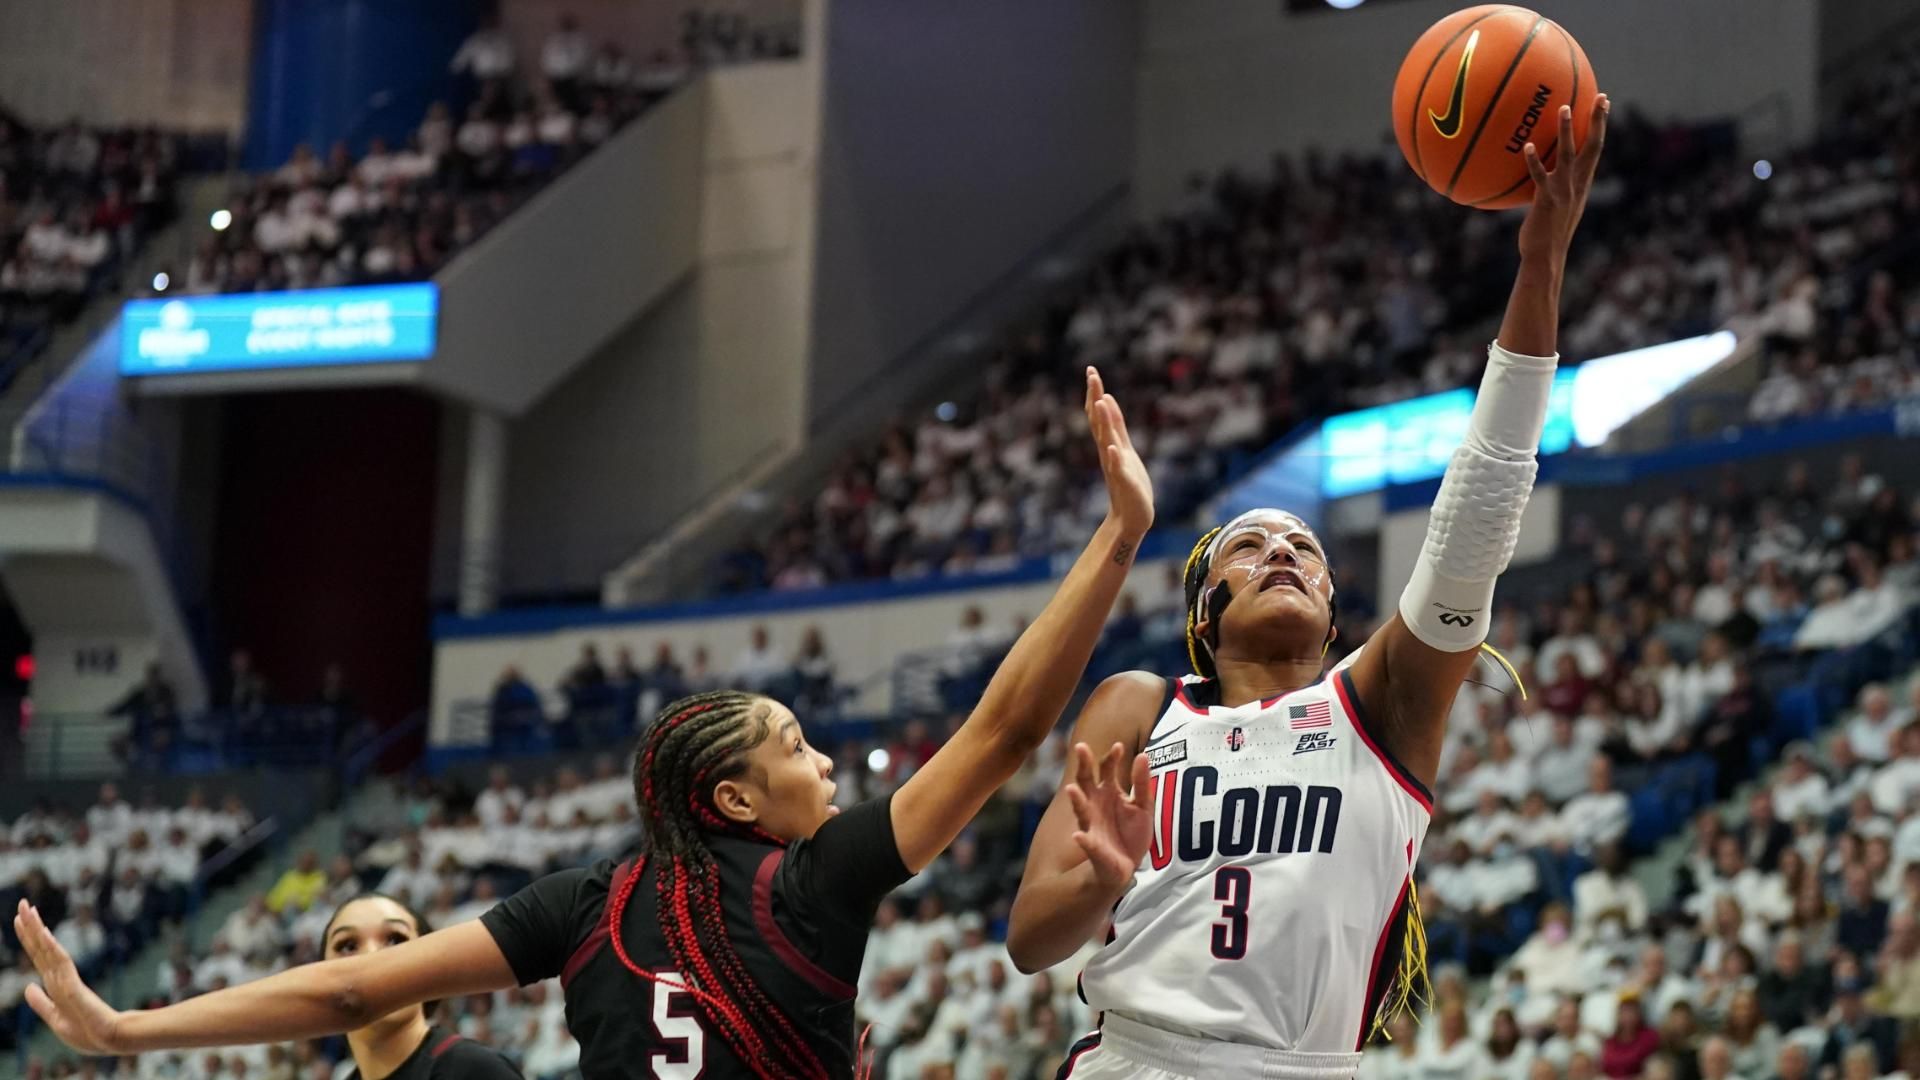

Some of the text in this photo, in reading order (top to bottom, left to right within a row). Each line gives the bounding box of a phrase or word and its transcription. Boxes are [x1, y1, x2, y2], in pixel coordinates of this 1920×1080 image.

[1505, 84, 1552, 154] UCONN
[1295, 738, 1337, 751] EAST
[1299, 731, 1329, 743] BIG
[1210, 865, 1252, 961] 3
[650, 970, 704, 1080] 5
